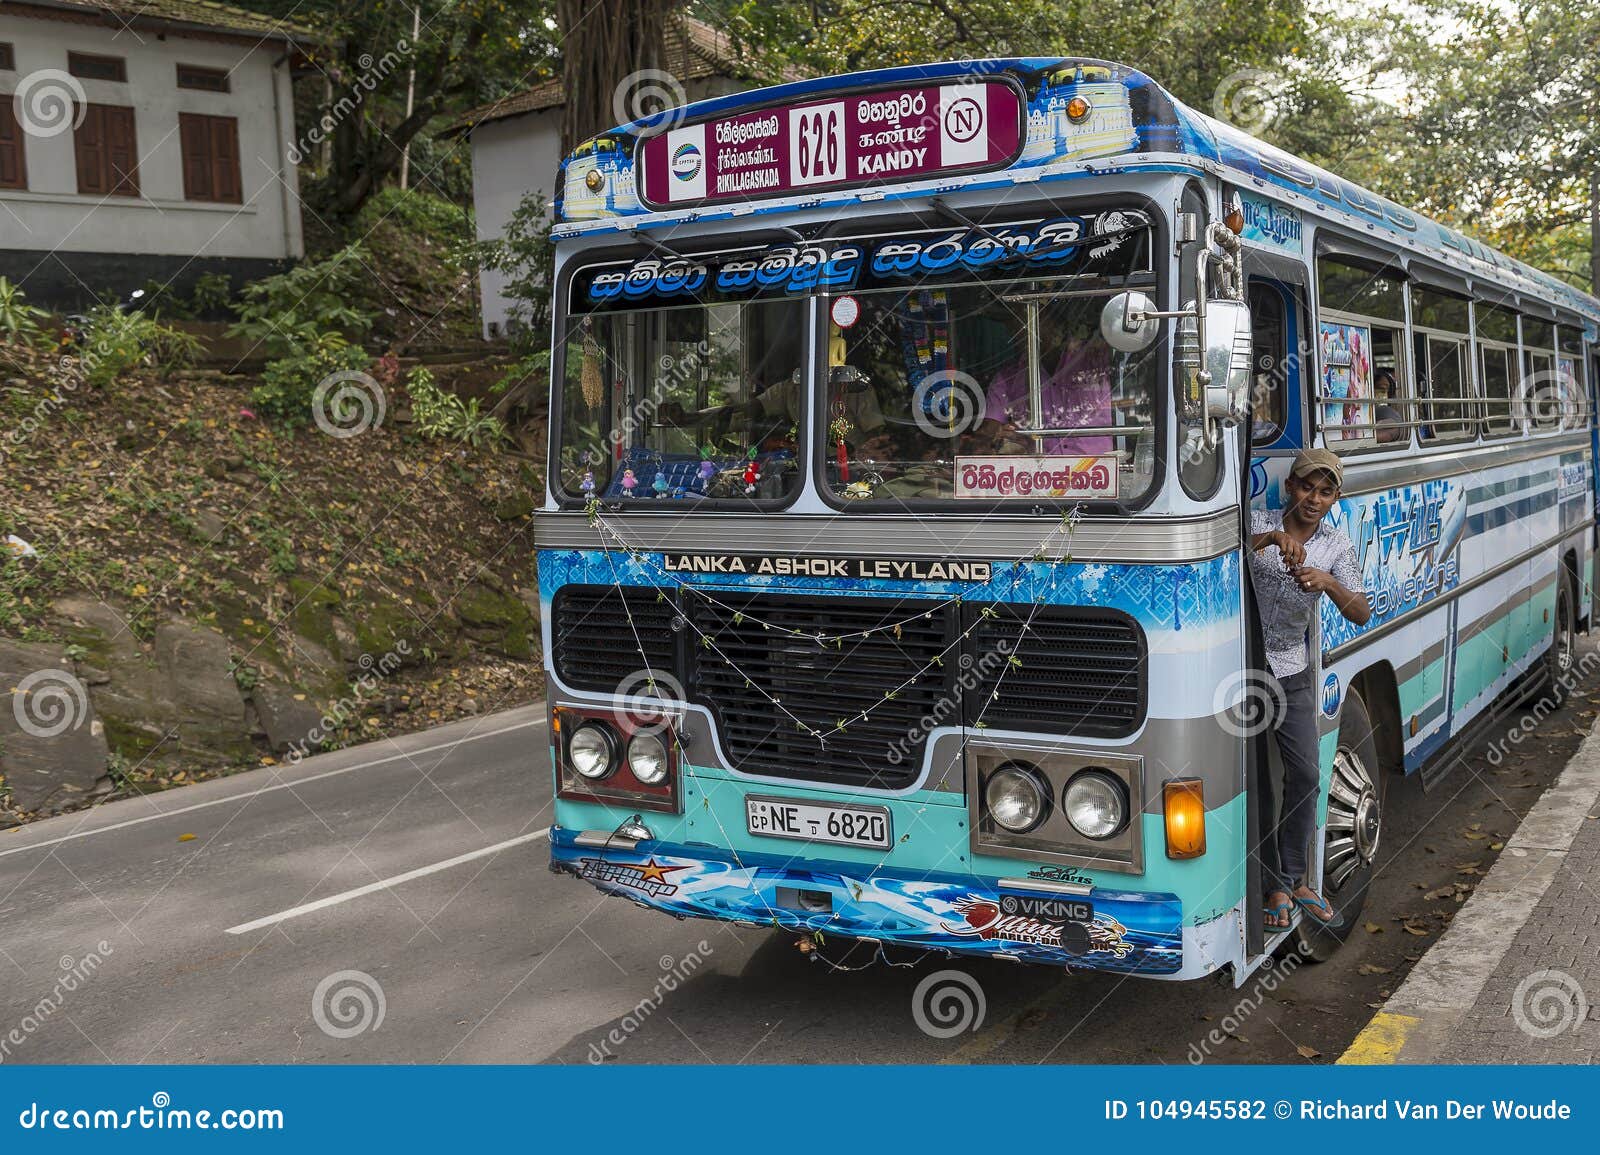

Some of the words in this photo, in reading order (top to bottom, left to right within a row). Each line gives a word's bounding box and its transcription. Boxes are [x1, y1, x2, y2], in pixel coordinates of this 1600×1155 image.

[857, 91, 927, 125] මහනුවර
[953, 107, 974, 133] N
[799, 110, 838, 178] 626
[858, 124, 927, 148] கண்டி
[857, 147, 928, 175] KANDY
[716, 167, 780, 194] RIKILLAGASKADA
[664, 555, 747, 573] LANKA
[757, 557, 848, 577] ASHOK
[859, 560, 990, 581] LEYLAND
[751, 815, 768, 830] CP
[770, 806, 801, 832] NE
[827, 811, 885, 842] 6820
[1020, 902, 1088, 919] VIKING
